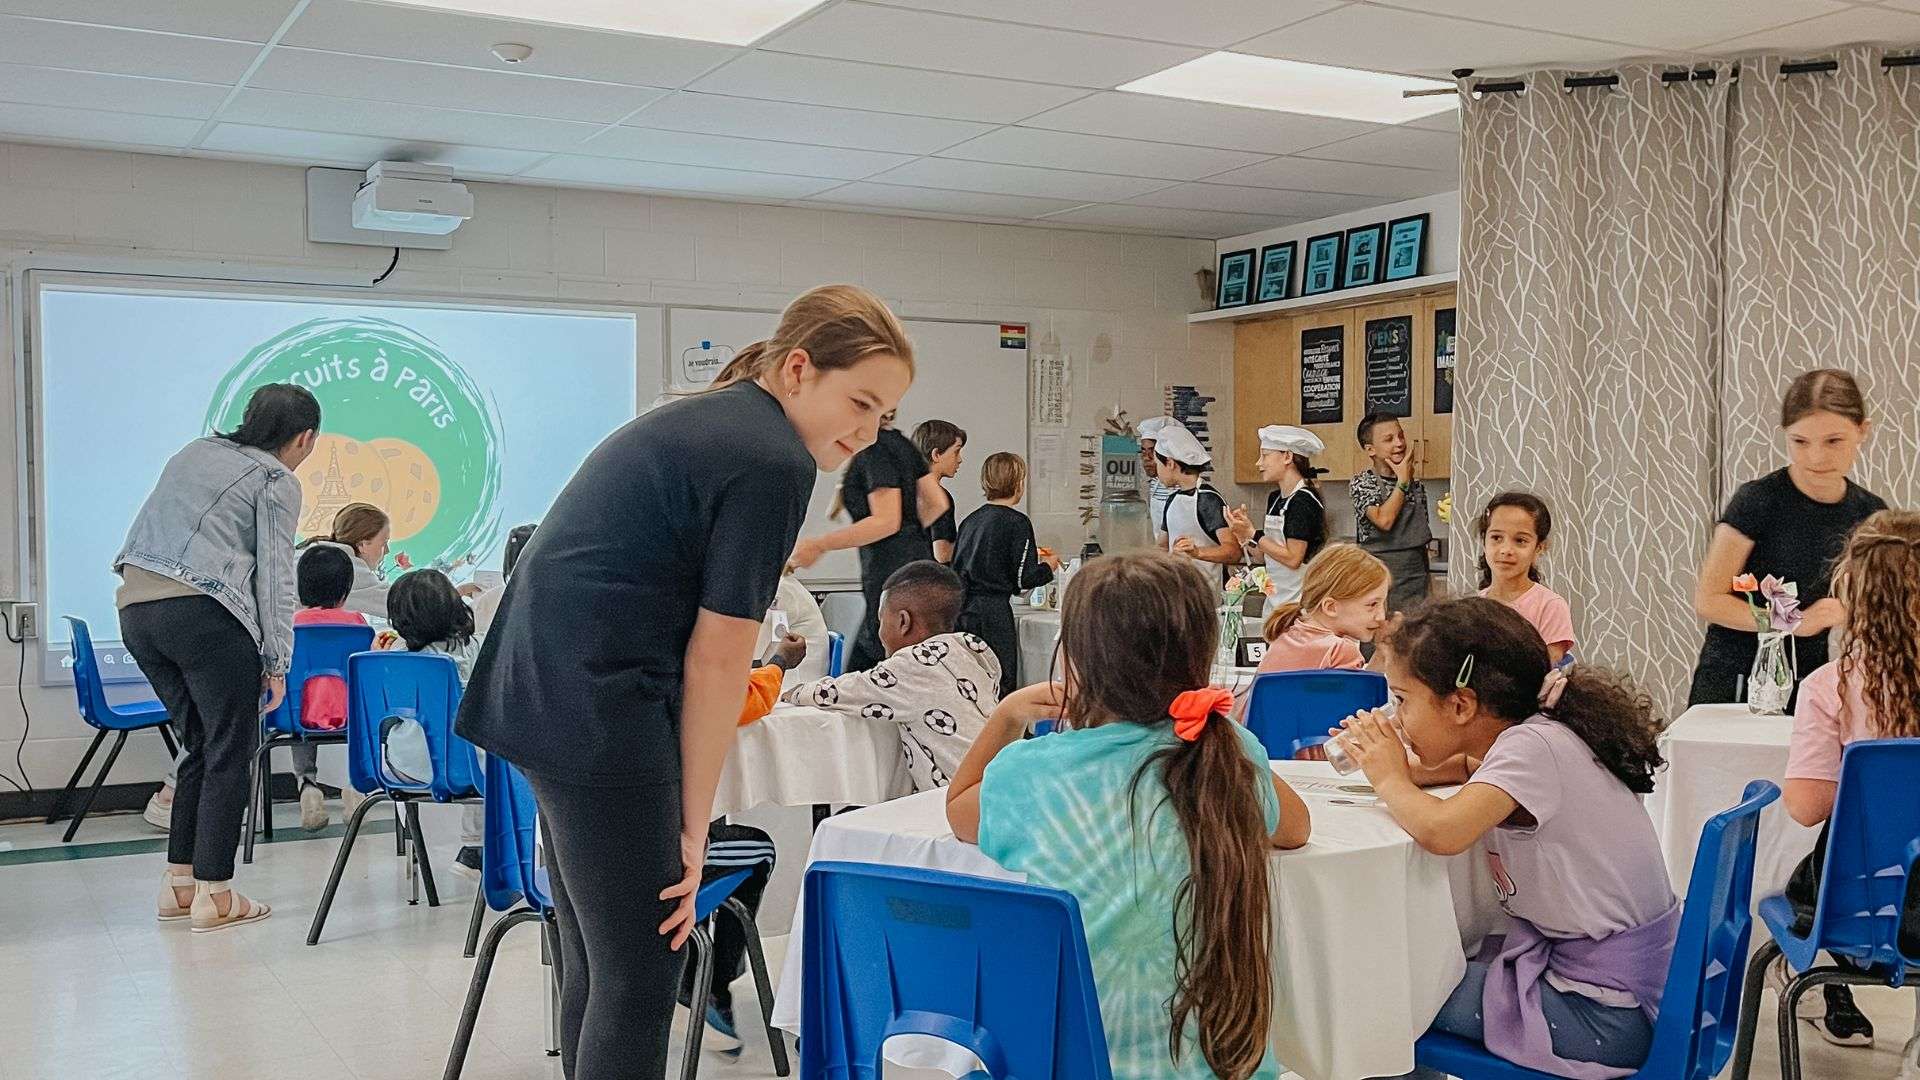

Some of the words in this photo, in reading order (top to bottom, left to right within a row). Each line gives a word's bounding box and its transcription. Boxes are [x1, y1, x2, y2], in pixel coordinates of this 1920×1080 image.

[1436, 355, 1456, 369] IMAG
[281, 354, 361, 390] cuits
[369, 347, 389, 382] à
[393, 366, 456, 429] Paris
[1106, 460, 1136, 475] OUI
[1253, 646, 1261, 658] 5
